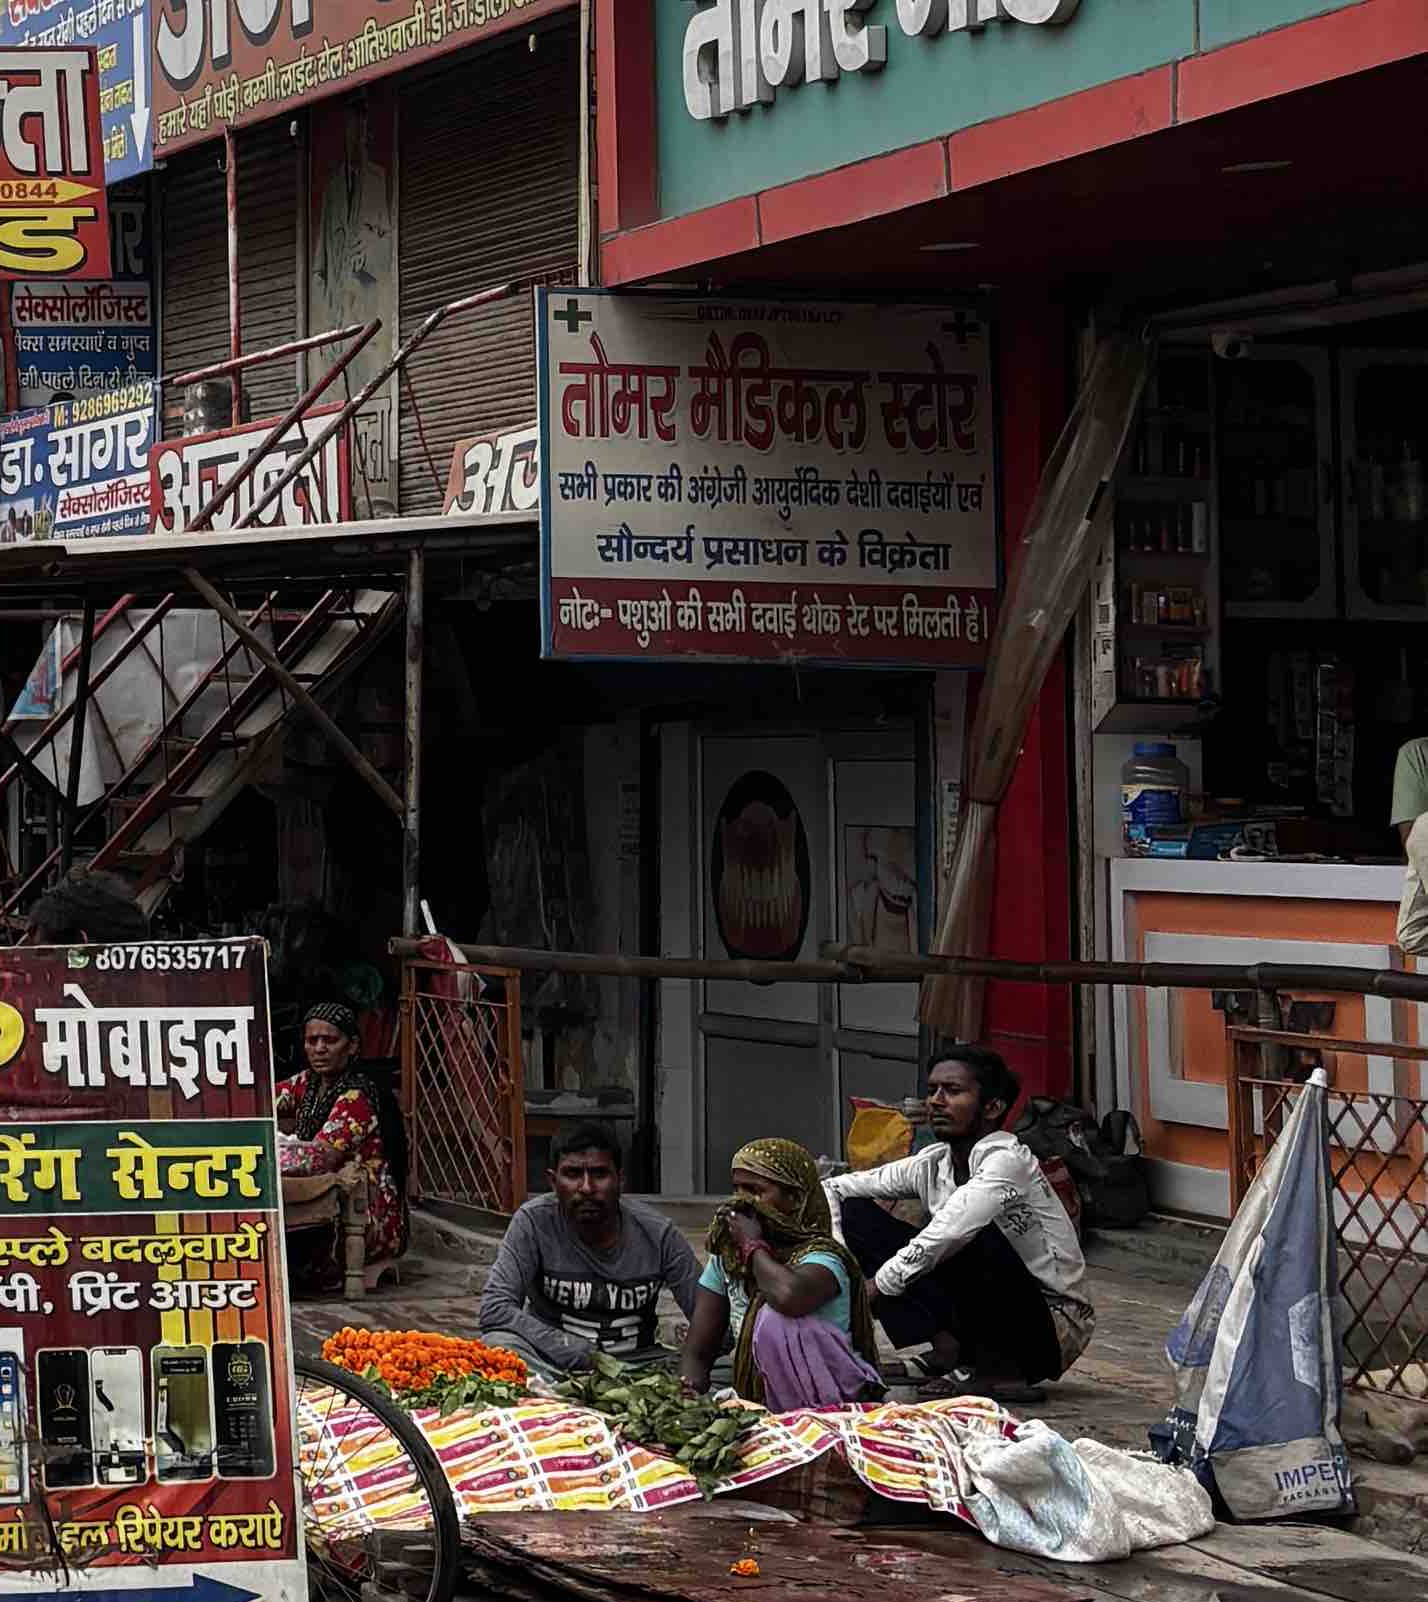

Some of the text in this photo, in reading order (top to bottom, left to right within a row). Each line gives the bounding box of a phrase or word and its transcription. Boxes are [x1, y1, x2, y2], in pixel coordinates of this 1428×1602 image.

[54, 404, 69, 429] M:
[72, 382, 153, 422] 9286969292
[559, 330, 979, 454] तोमर मैडिकल स्टोर
[559, 461, 598, 502] सभी
[601, 471, 655, 507] प्रकार
[656, 463, 684, 503] की
[687, 466, 747, 510] अंग्रेजी
[752, 466, 842, 520] आयुर्वेदिक
[846, 469, 881, 510] देशी
[956, 474, 986, 512] एवं
[597, 522, 953, 574] सौन्दर्य प्रसाधन के विक्रेता
[676, 587, 704, 633] की
[707, 588, 746, 634] सभी
[750, 589, 798, 640] दवाई
[802, 591, 843, 637] थोक
[846, 592, 871, 638] रेट
[872, 603, 899, 638] पर
[902, 593, 962, 641] मिलती
[95, 945, 246, 971] 8076535717
[34, 983, 255, 1100] मोबाइल
[107, 1131, 263, 1201] सेन्टर
[79, 1222, 268, 1267] बदलवायें
[67, 1271, 143, 1317] प्रिंट
[148, 1278, 259, 1311] आउट
[544, 1275, 593, 1311] NEW
[114, 1504, 203, 1553] रिपेयर
